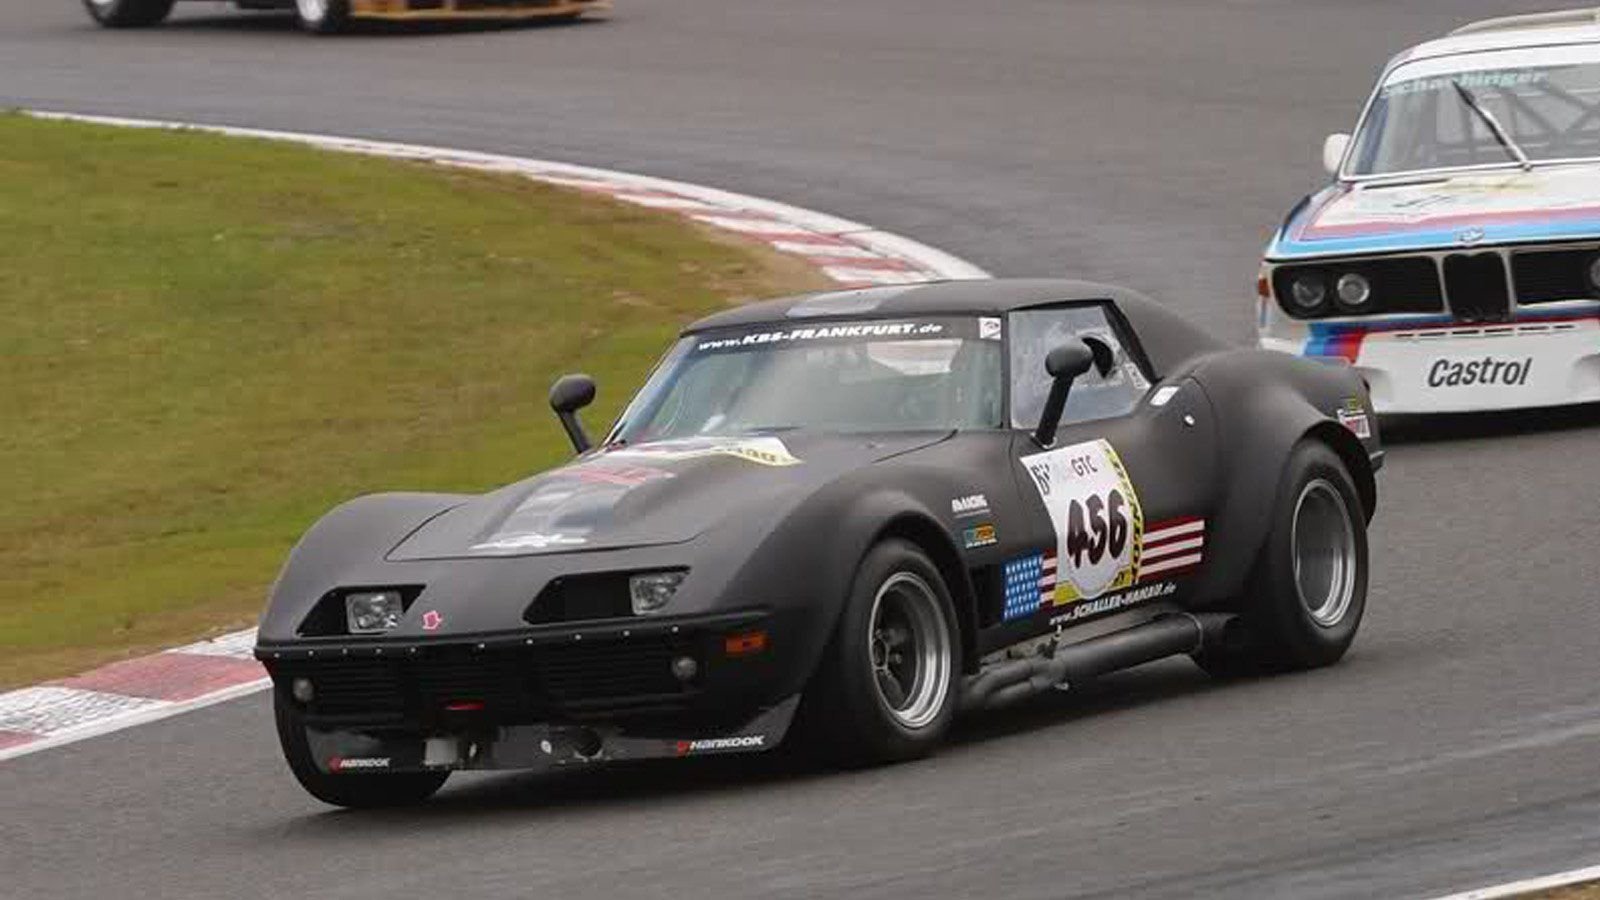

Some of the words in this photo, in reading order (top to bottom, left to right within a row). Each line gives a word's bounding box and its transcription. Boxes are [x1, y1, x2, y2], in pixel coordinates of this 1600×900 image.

[1428, 356, 1532, 388] Castrol
[1071, 455, 1098, 477] GTC
[1066, 489, 1127, 569] 456
